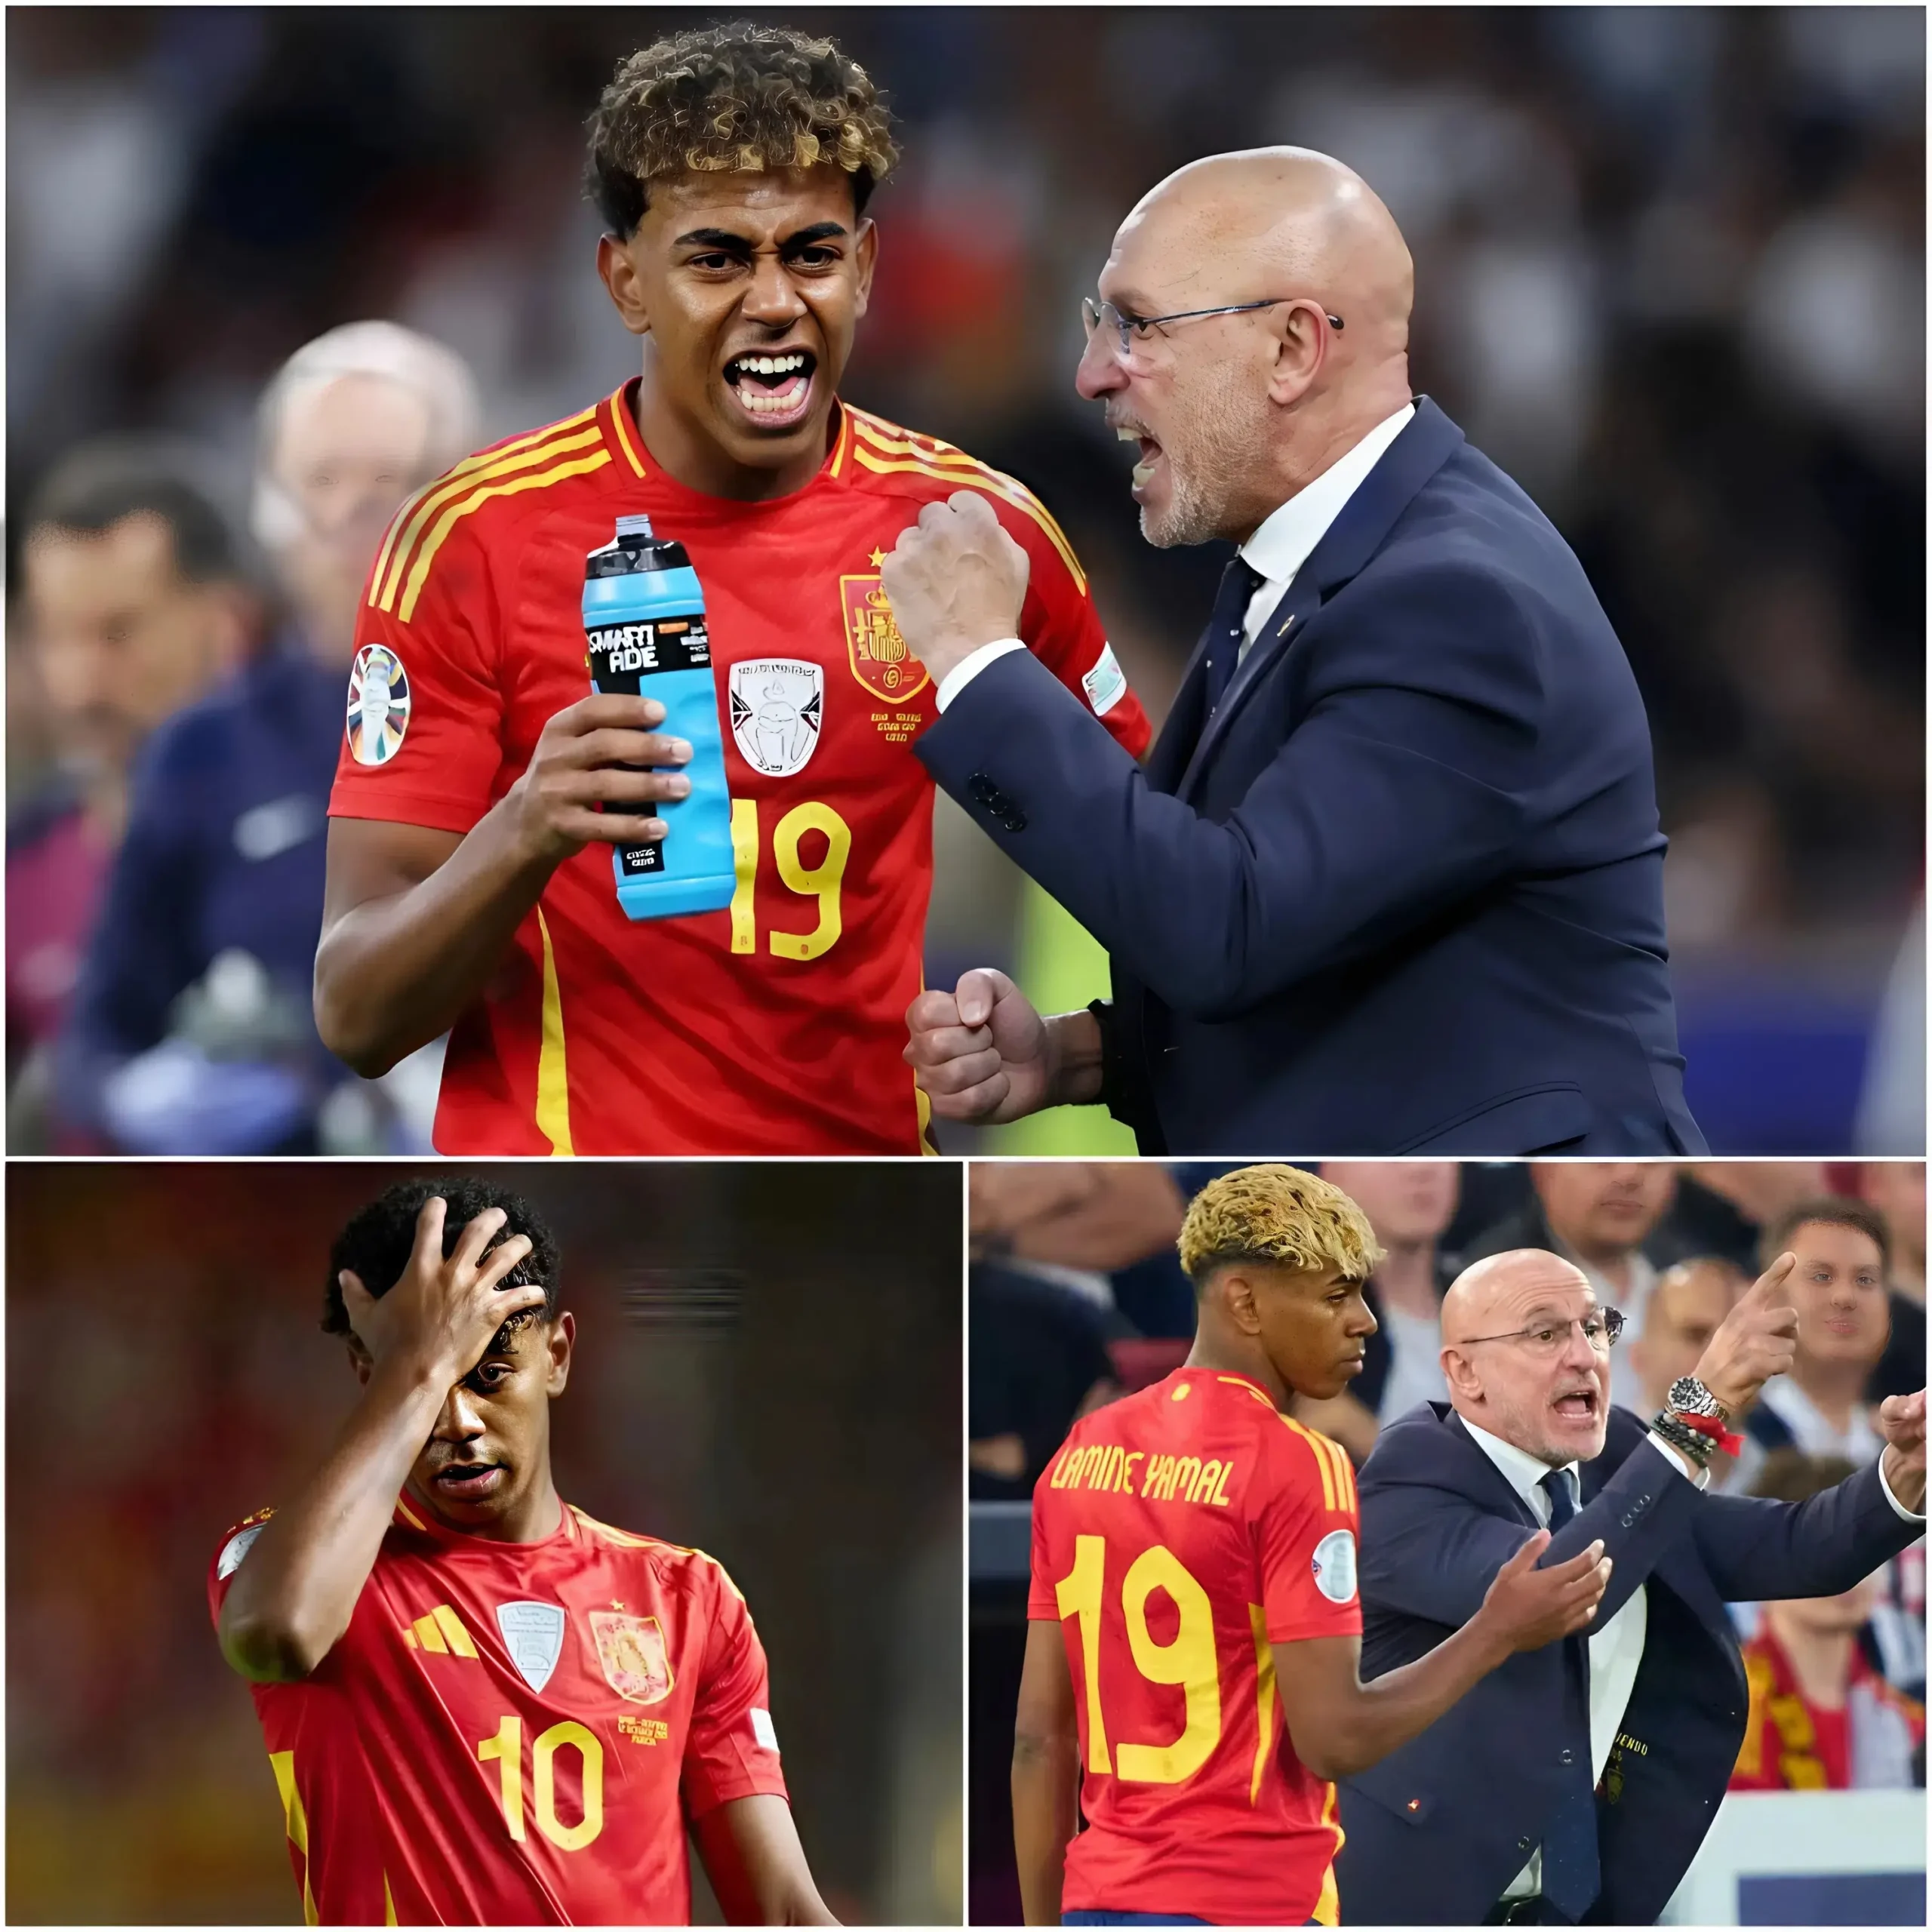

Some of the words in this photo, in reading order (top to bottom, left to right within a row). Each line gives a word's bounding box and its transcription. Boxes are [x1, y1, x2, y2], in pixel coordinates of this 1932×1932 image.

[609, 646, 659, 673] ADE
[730, 798, 851, 961] 19
[1050, 1445, 1145, 1494] LAMINE
[1140, 1454, 1234, 1506] YAMAL
[1055, 1534, 1221, 1784] 19
[478, 1715, 603, 1852] 10
